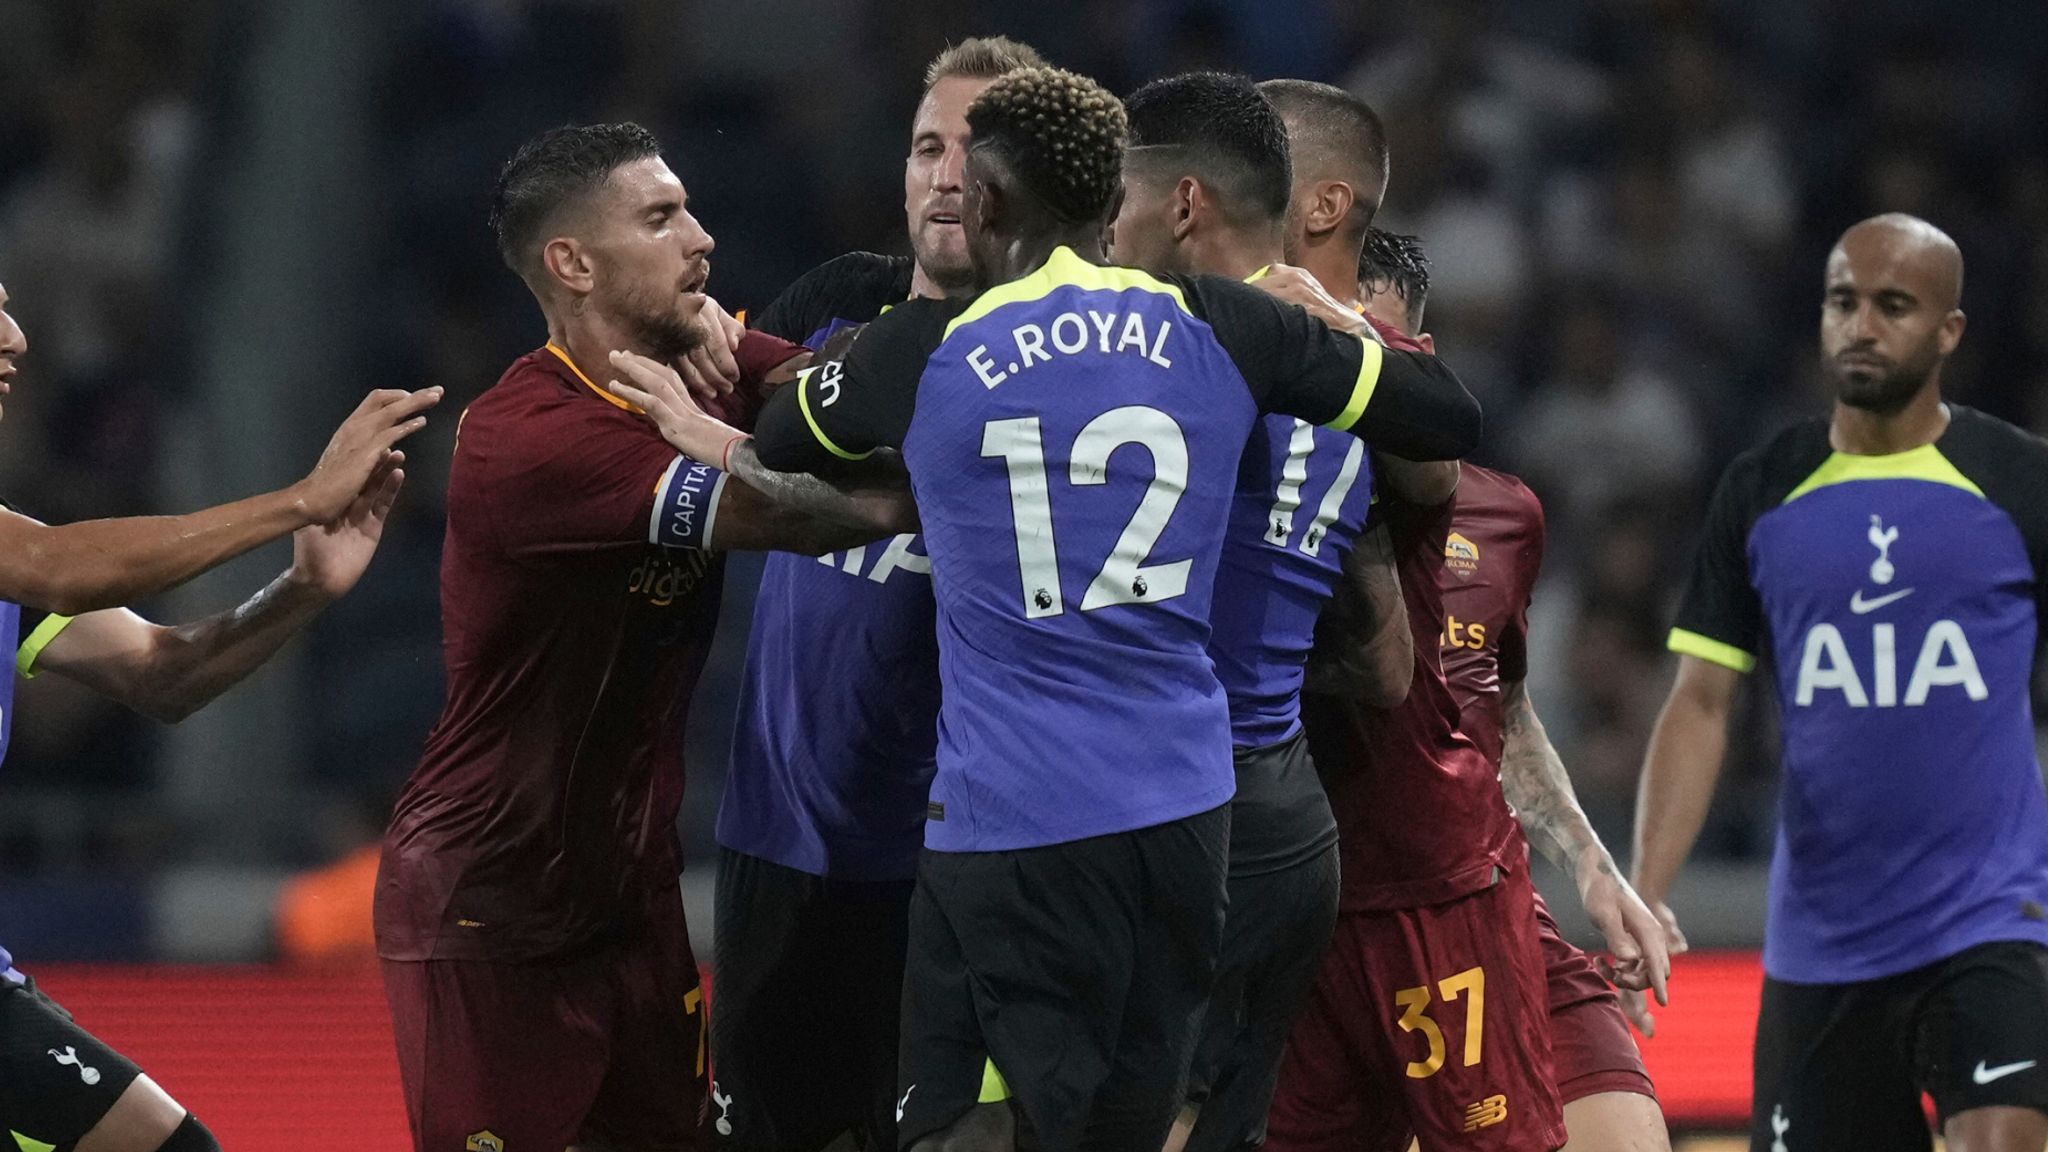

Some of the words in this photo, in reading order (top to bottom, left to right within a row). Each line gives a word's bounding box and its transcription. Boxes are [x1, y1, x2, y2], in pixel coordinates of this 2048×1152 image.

[965, 309, 1174, 390] E.ROYAL
[671, 456, 711, 538] CAPITA
[980, 404, 1194, 619] 12
[1446, 559, 1478, 571] ROMA
[1439, 615, 1487, 650] ts
[1795, 619, 1990, 708] AIA
[1395, 966, 1486, 1079] 37
